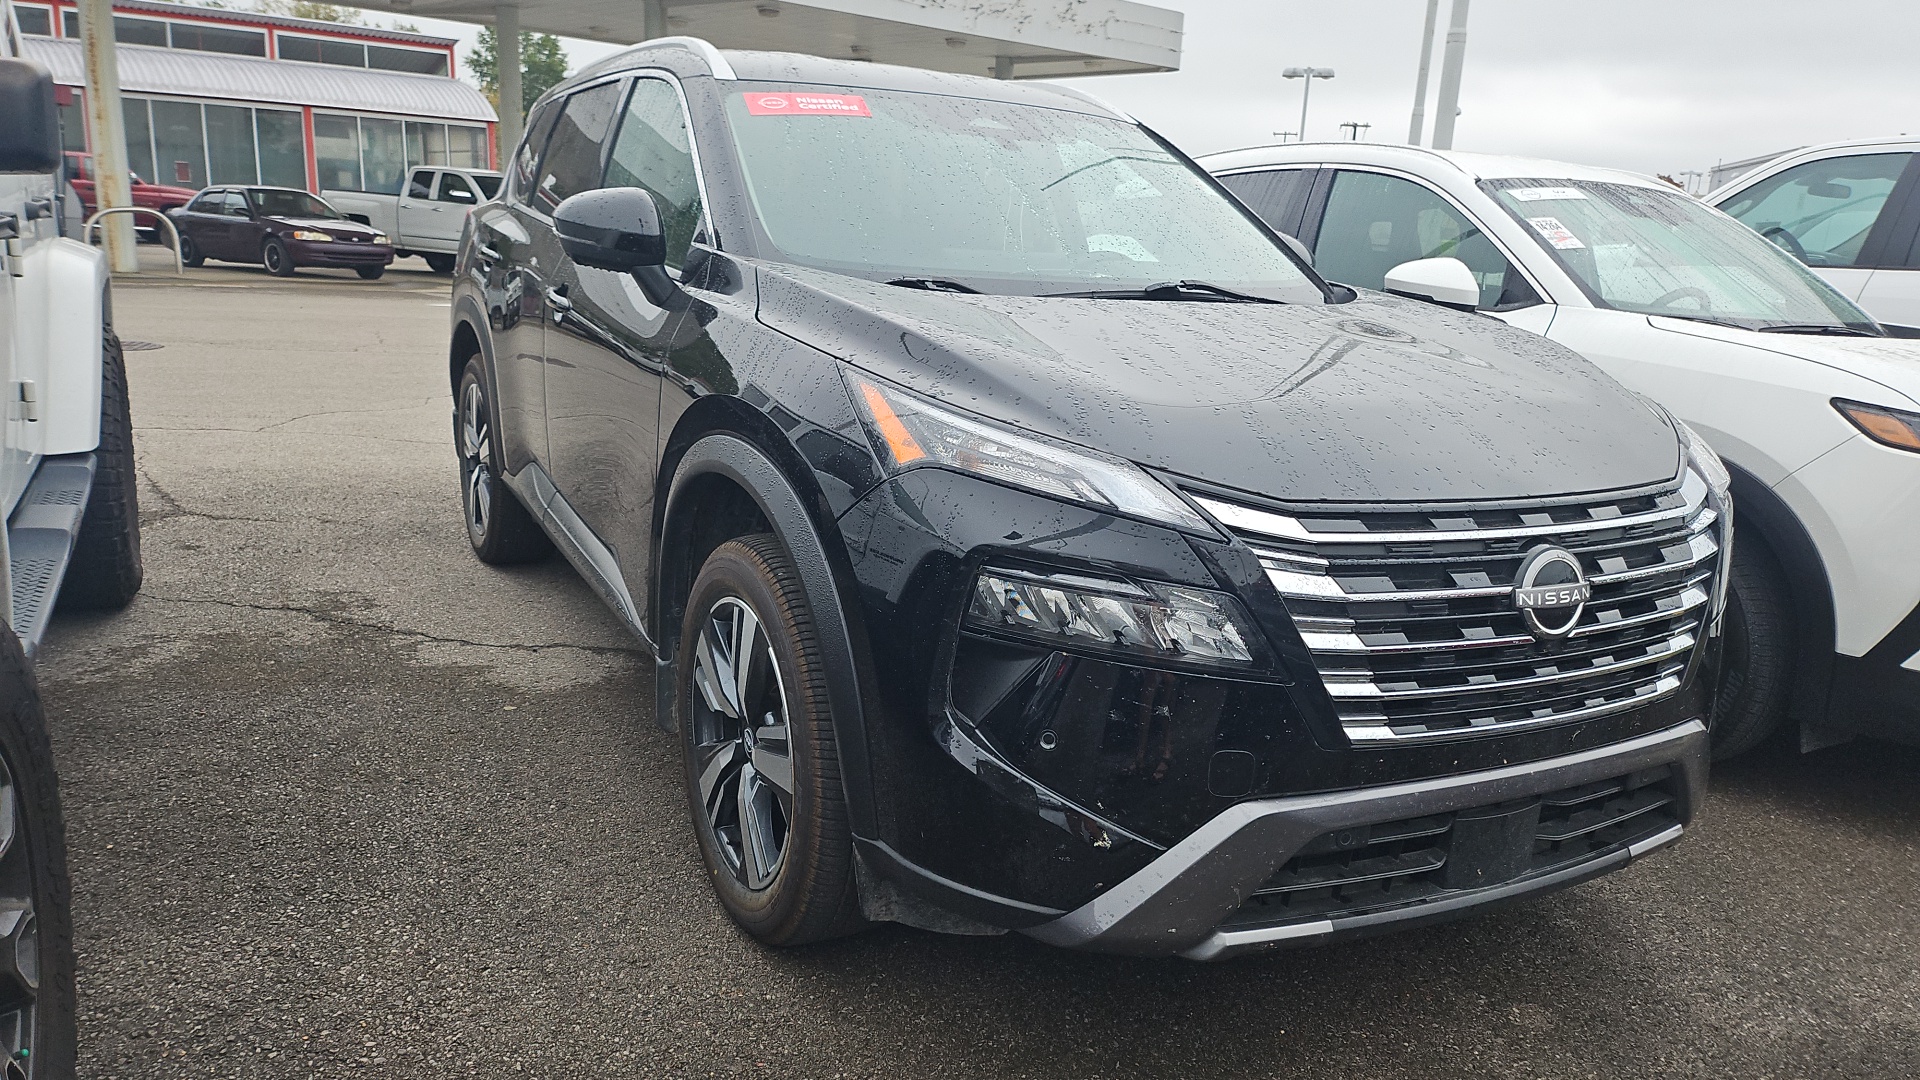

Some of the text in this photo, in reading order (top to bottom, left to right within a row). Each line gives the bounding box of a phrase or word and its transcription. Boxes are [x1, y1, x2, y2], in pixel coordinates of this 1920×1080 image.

[795, 97, 844, 105] Nissan
[798, 103, 859, 111] Certified
[1519, 585, 1590, 605] NISSAN
